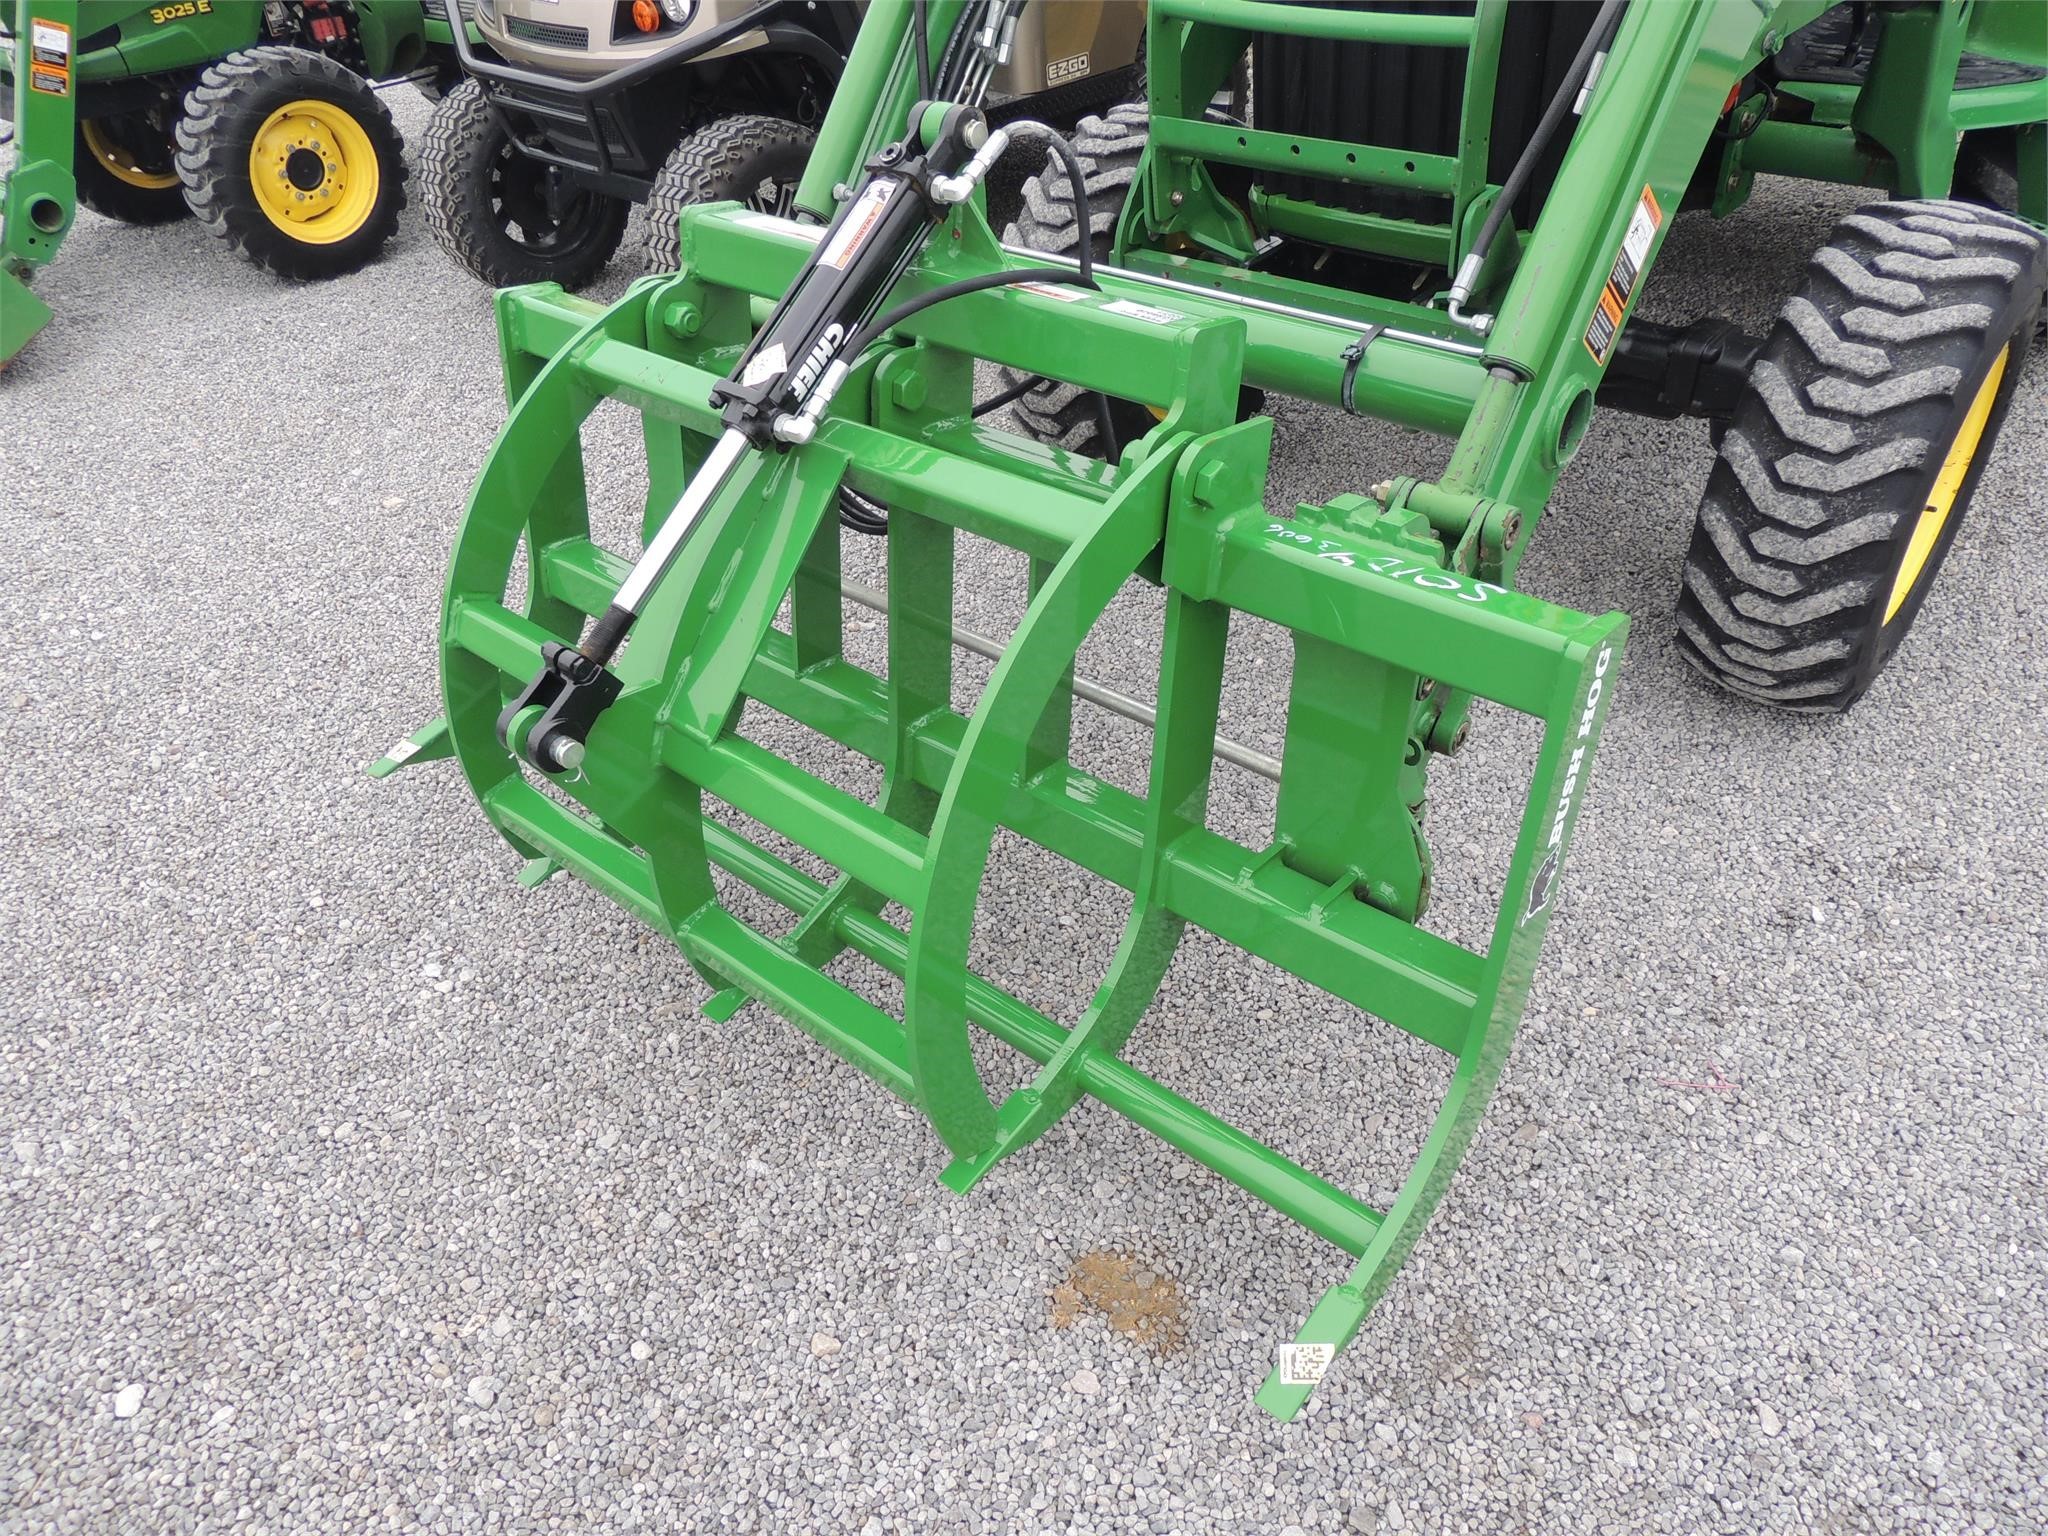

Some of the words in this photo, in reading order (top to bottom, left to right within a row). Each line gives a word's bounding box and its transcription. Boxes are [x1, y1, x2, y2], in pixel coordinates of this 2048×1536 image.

[150, 2, 196, 24] 3025
[197, 0, 212, 13] E
[788, 323, 844, 403] CHIEF
[1547, 745, 1586, 849] BUSH
[1577, 646, 1613, 740] HOG
